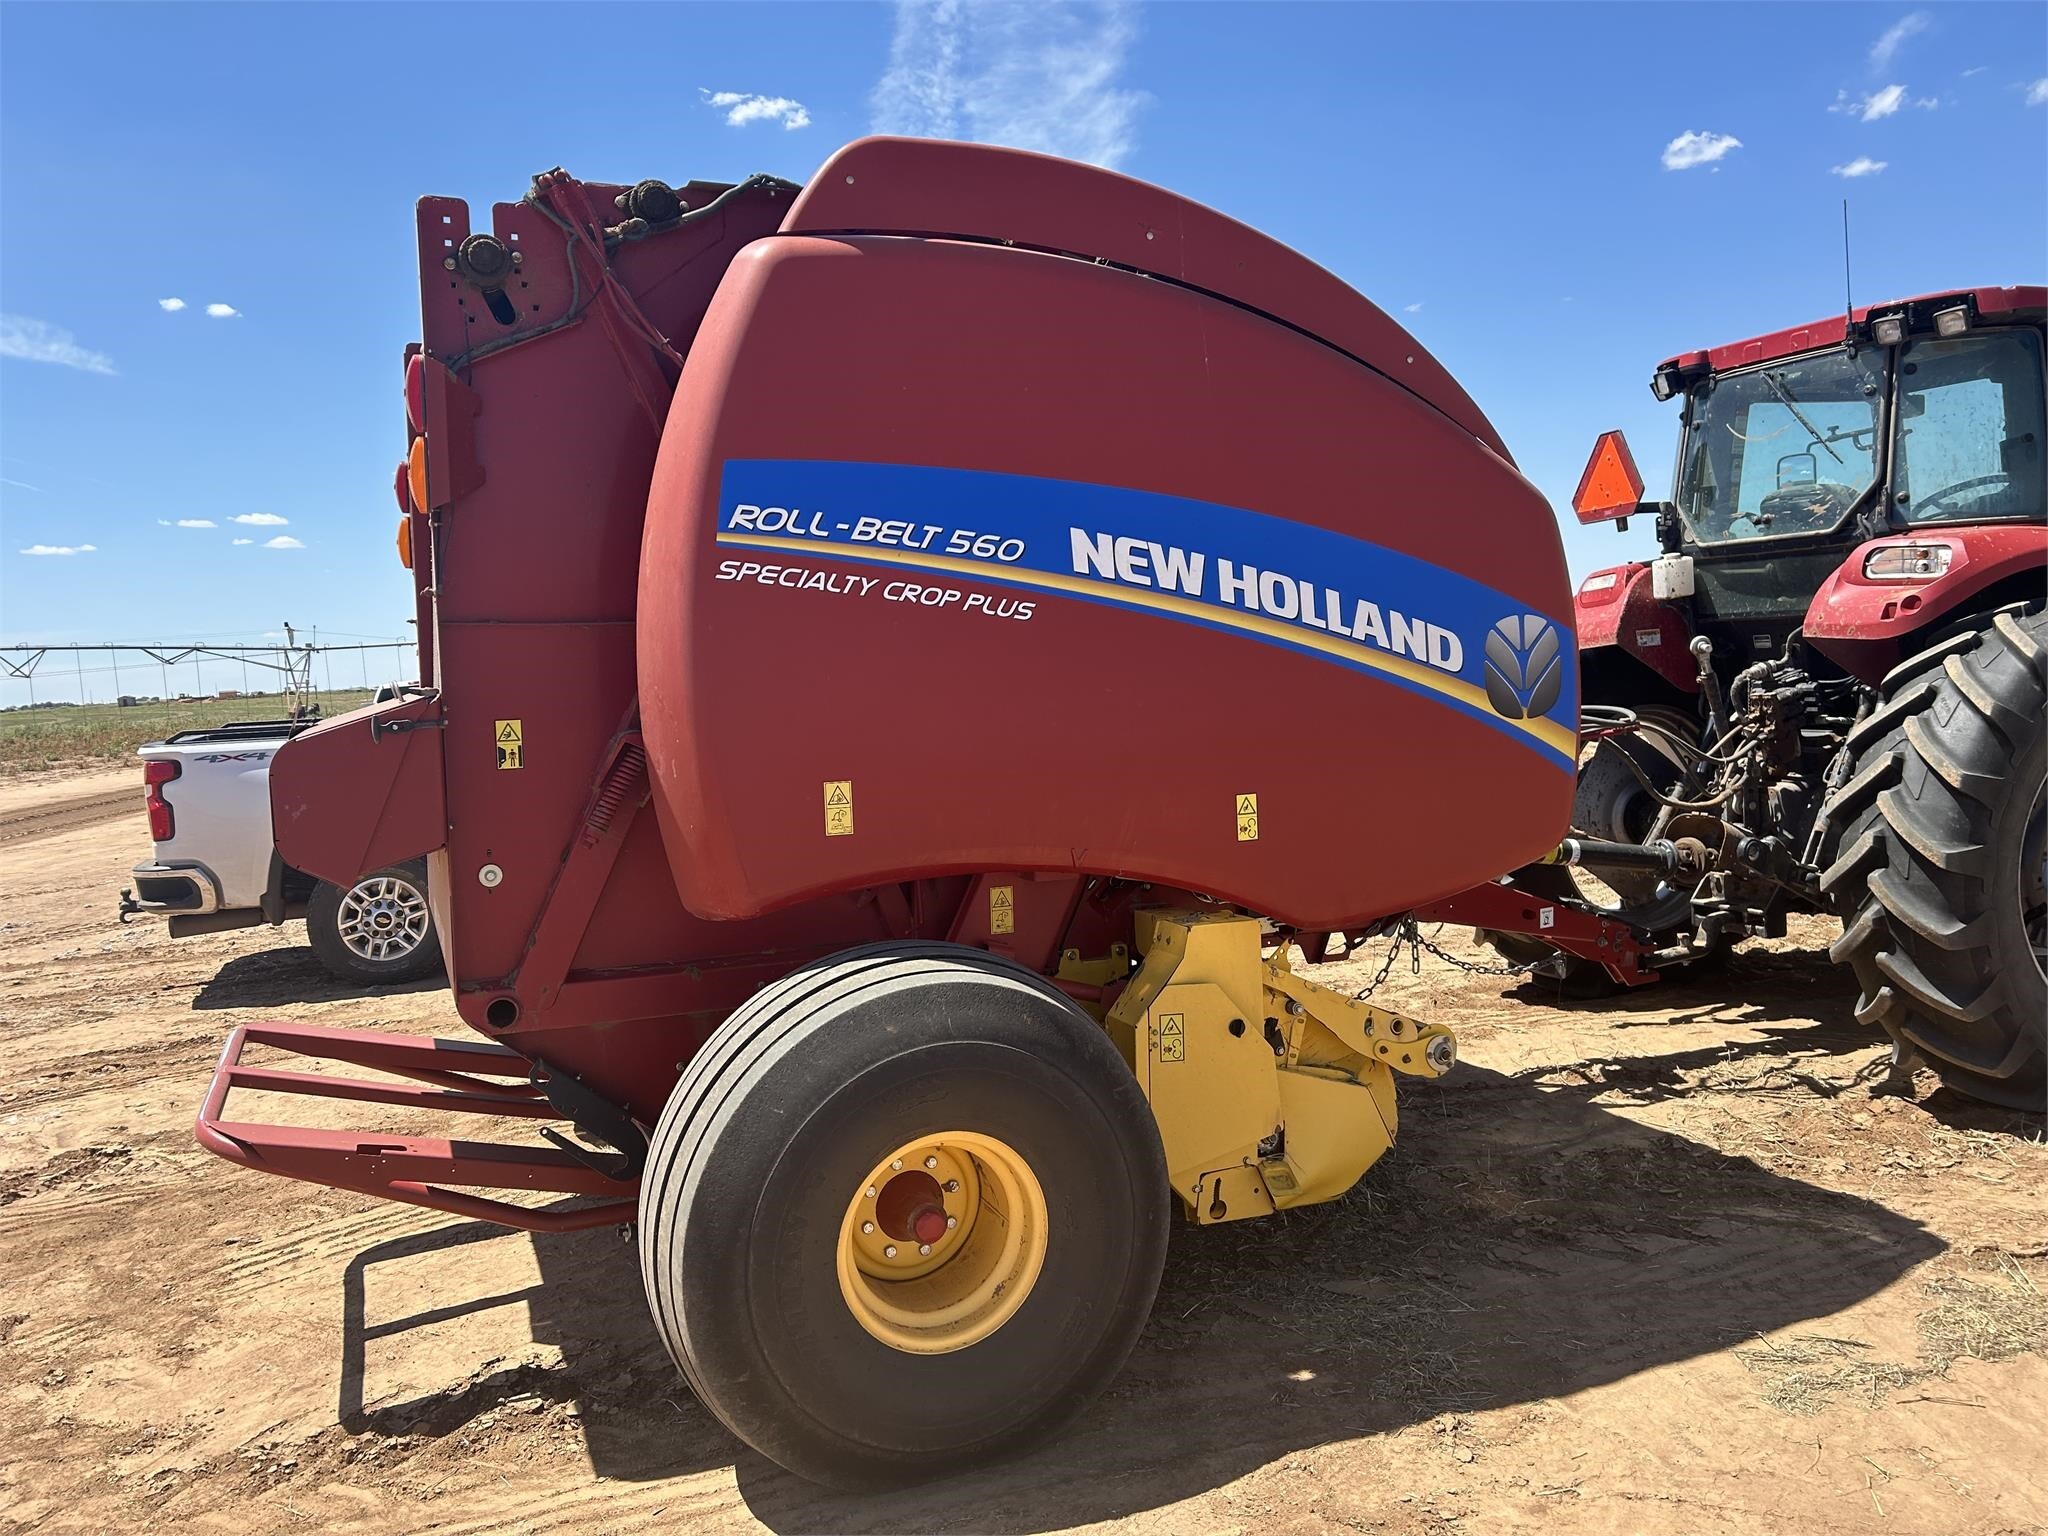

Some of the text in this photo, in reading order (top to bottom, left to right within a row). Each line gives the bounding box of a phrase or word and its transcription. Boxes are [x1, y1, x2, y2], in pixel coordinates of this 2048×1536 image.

[728, 504, 1026, 562] ROLL-BELT 560
[715, 560, 1037, 622] SPECIALTY CROP PLUS
[1070, 527, 1464, 673] NEW HOLLAND
